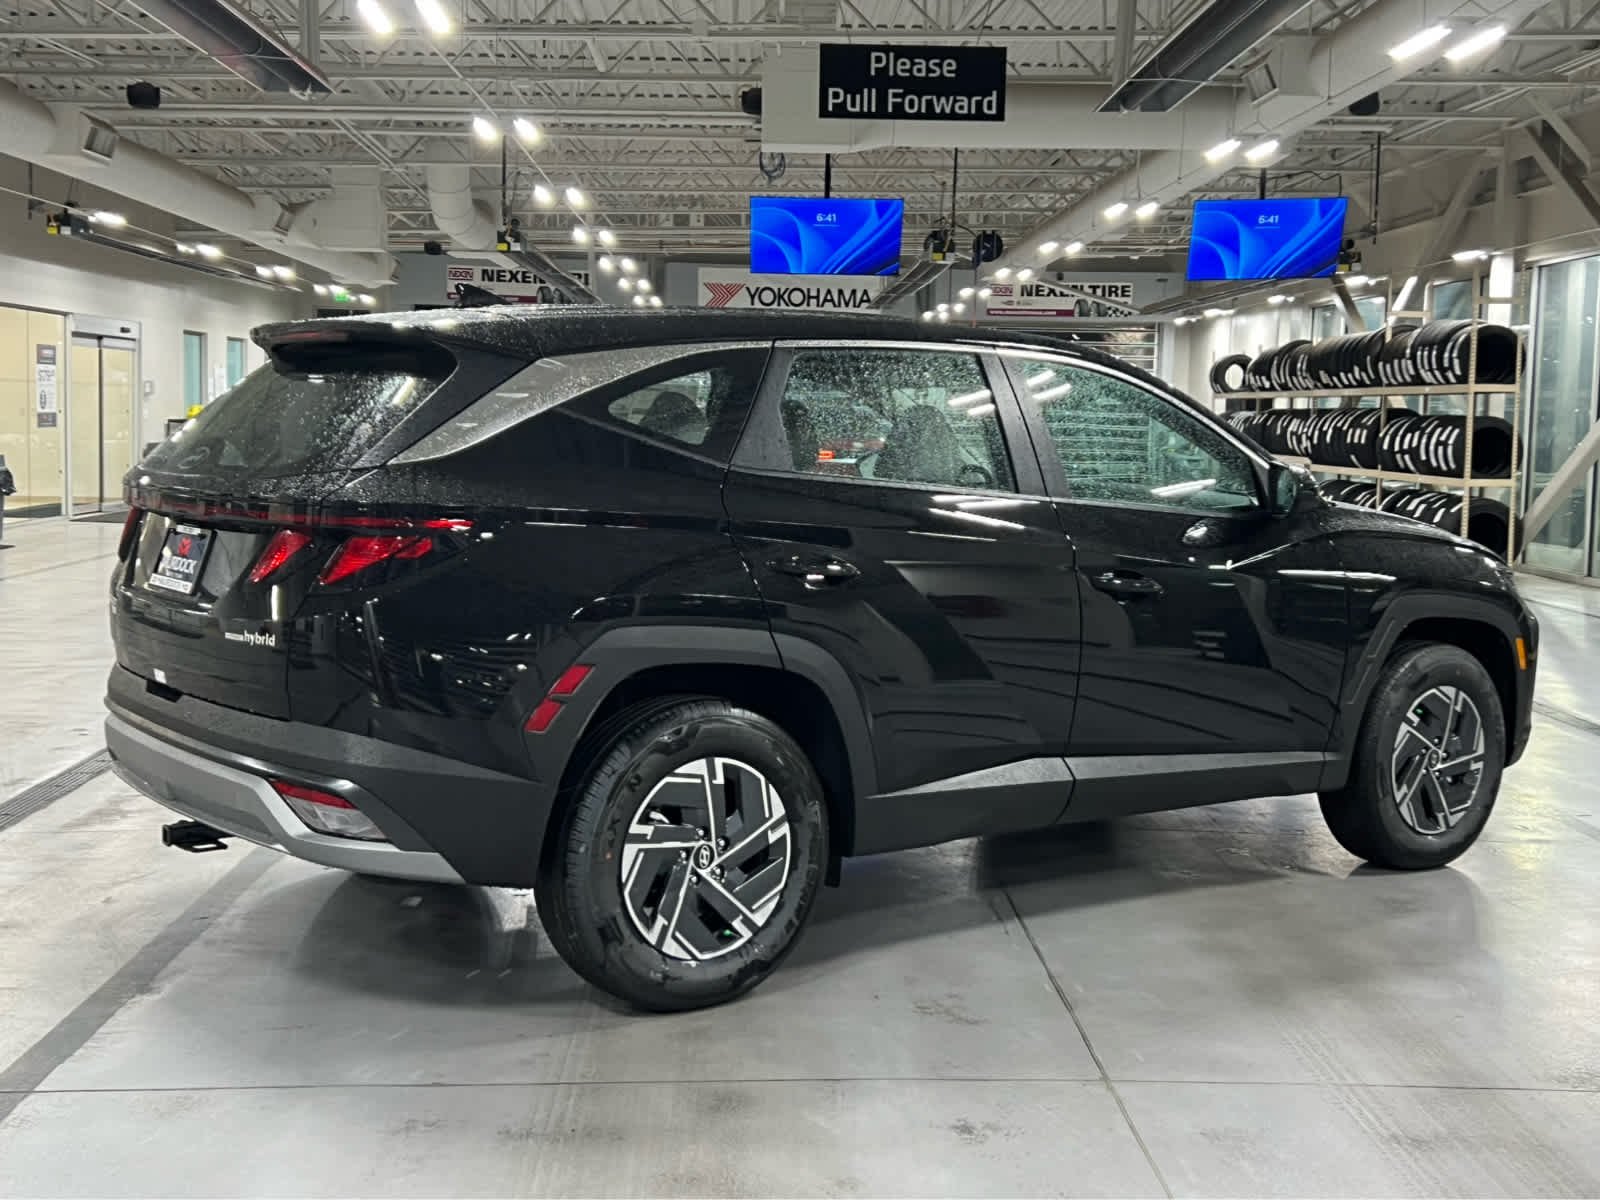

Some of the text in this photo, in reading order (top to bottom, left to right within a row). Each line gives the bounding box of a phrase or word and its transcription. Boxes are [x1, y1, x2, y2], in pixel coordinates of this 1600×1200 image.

[869, 51, 958, 78] Please
[827, 87, 998, 115] Pull Forward
[816, 213, 837, 223] 6:41
[1258, 214, 1279, 224] 6:41
[746, 286, 873, 309] YOKOHAMA
[1088, 284, 1132, 298] TIRE
[244, 630, 276, 647] hybrid
